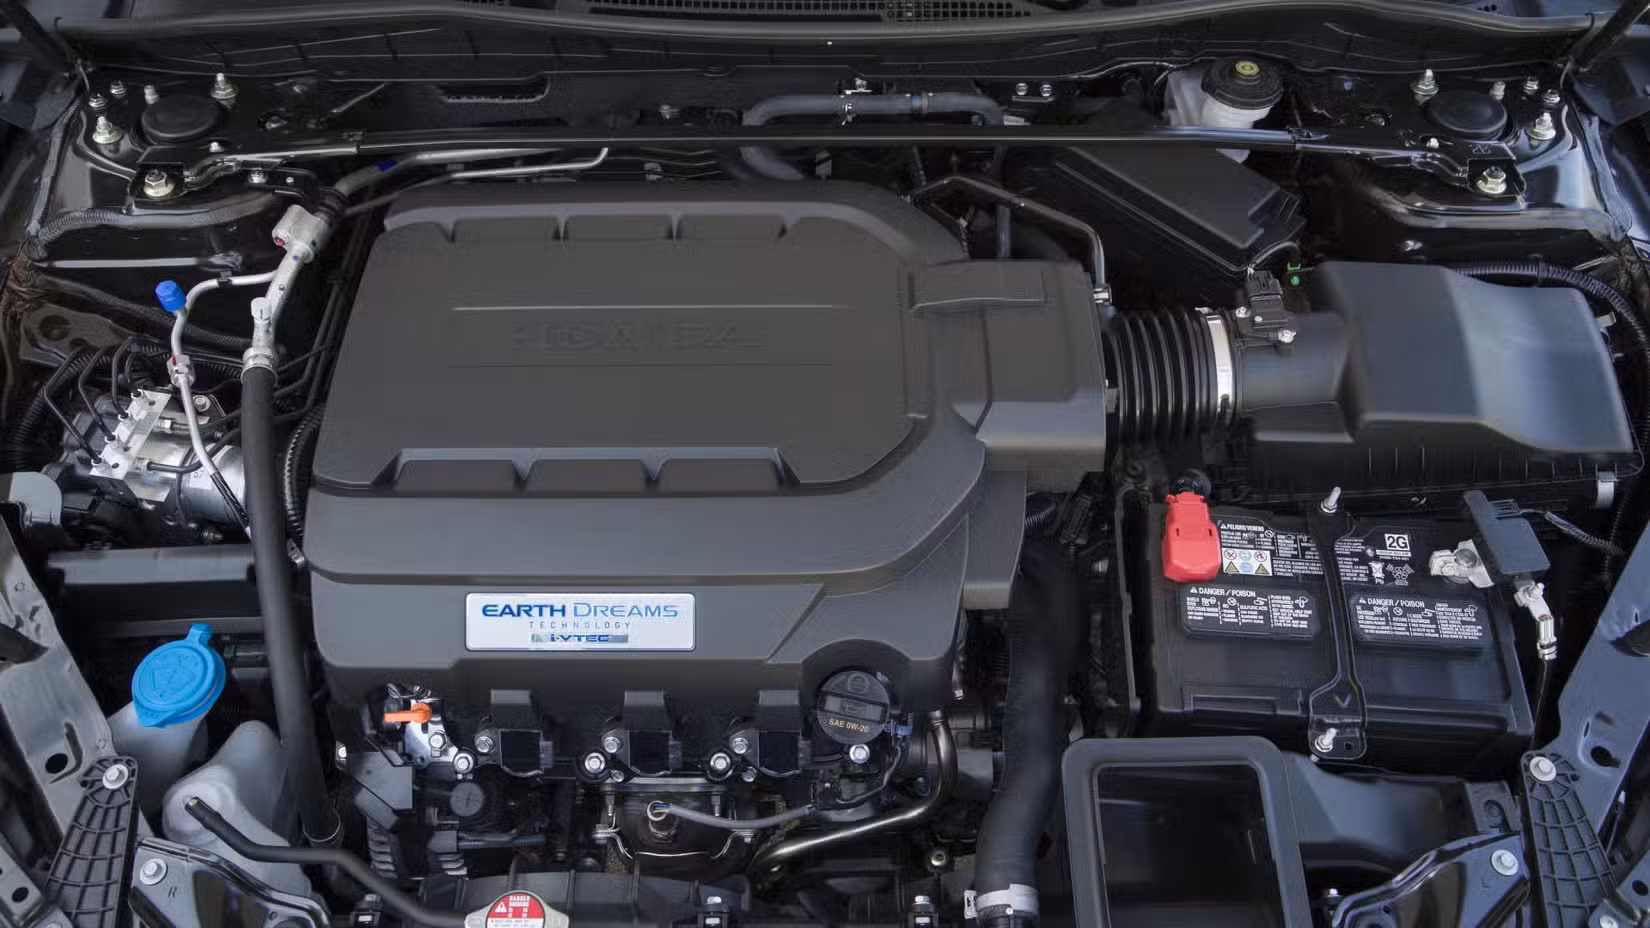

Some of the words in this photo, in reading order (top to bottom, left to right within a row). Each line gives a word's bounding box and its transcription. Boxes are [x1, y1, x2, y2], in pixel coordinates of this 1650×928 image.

[1387, 535, 1409, 549] 2G
[1198, 587, 1225, 596] DANGER
[1231, 589, 1256, 598] POISON
[1367, 597, 1394, 606] DANGER
[1400, 599, 1425, 608] POISON
[482, 604, 566, 617] EARTH
[572, 602, 679, 617] DREAMS
[529, 621, 631, 629] TECHNOLOGY
[829, 719, 844, 728] SAE
[846, 722, 868, 732] 0W-20
[168, 886, 177, 898] R
